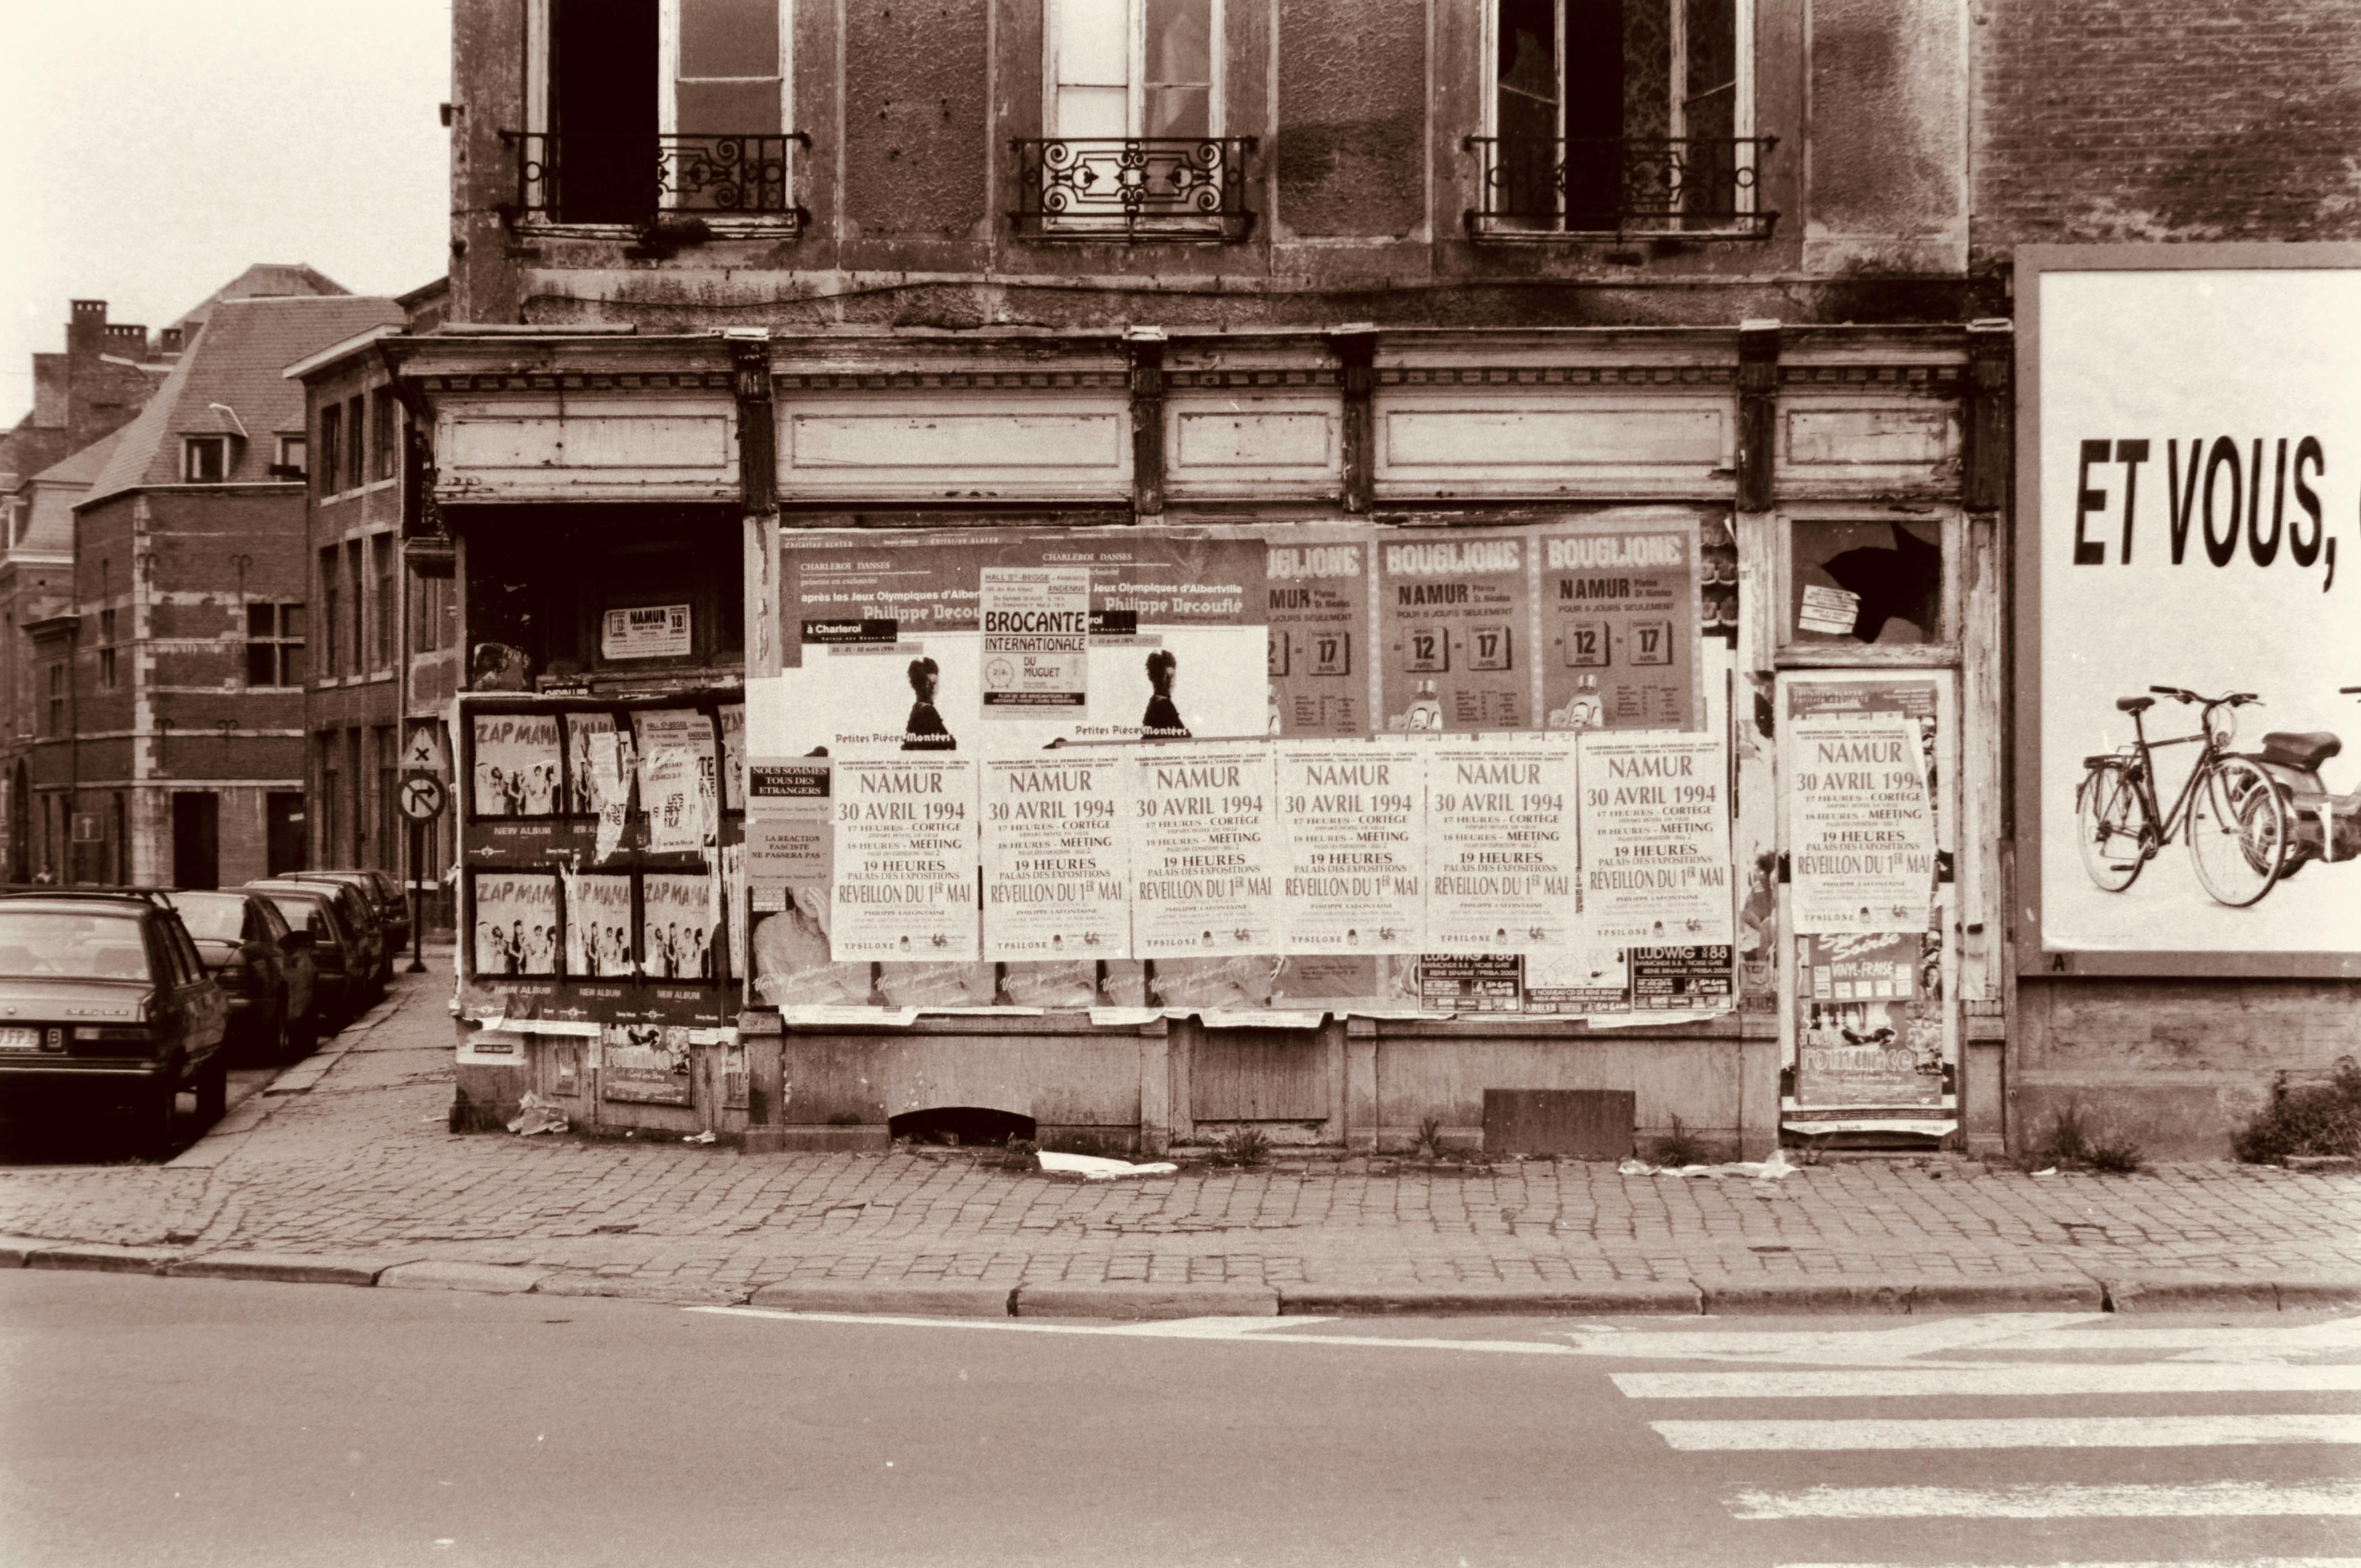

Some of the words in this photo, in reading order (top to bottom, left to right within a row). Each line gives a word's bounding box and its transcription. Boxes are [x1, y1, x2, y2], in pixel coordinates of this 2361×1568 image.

[2073, 439, 2150, 566] ET
[2167, 435, 2337, 593] VOUS,
[1100, 553, 1132, 561] DANSES
[1387, 540, 1520, 575] BOUGLIONE
[1548, 535, 1682, 569] BOUGLIONE
[801, 593, 830, 604] après
[834, 593, 848, 601] les
[851, 592, 874, 601] Jeux
[877, 590, 938, 601] Olympiques
[941, 590, 980, 599] d'Alber
[1094, 584, 1116, 593] Jeux
[1119, 583, 1177, 594] Olympiques
[1180, 583, 1243, 594] d'Albertville
[1398, 584, 1468, 605] NAMUR
[1560, 578, 1629, 599] NAMUR
[1105, 597, 1168, 615] Philippe
[1172, 597, 1243, 613] Decouflé
[1270, 589, 1310, 609] MUR
[630, 610, 665, 624] NAMUR
[671, 615, 682, 628] 18
[862, 605, 929, 623] Philippe
[932, 604, 980, 619] Decou
[986, 611, 1085, 632] BROCANTE
[1304, 614, 1352, 622] SEULEMENT
[1397, 610, 1420, 618] POUR
[1432, 609, 1459, 617] JOURS
[1464, 607, 1513, 616] SEULEMENT
[807, 625, 813, 633] à
[816, 624, 862, 633] Charleroi
[985, 638, 1085, 651] INTERNATIONALE
[1413, 636, 1435, 659] 12
[1477, 634, 1497, 658] 17
[1574, 631, 1596, 654] 12
[1639, 629, 1659, 652] 17
[1318, 639, 1337, 663] 17
[1024, 657, 1036, 666] DU
[1024, 668, 1060, 678] MUGUET
[476, 722, 513, 744] ZAP
[836, 734, 870, 743] Petites
[905, 733, 951, 742] Montées
[1076, 726, 1110, 735] Petites
[1143, 724, 1189, 735] Montées
[1819, 743, 1900, 764] NAMUR
[1307, 765, 1389, 786] NAMUR
[1457, 764, 1541, 785] NAMUR
[1609, 755, 1692, 778] NAMUR
[861, 773, 942, 793] NAMUR
[1010, 770, 1092, 793] NAMUR
[1157, 766, 1240, 789] NAMUR
[1797, 774, 1817, 791] 30
[1824, 773, 1874, 791] AVRIL
[1882, 772, 1923, 790] 1994
[1285, 796, 1305, 813] 30
[1312, 795, 1362, 812] AVRIL
[1371, 794, 1412, 812] 1994
[1435, 794, 1456, 812] 30
[1462, 794, 1513, 811] AVRIL
[1521, 794, 1563, 812] 1994
[1587, 788, 1608, 806] 30
[1615, 787, 1666, 805] AVRIL
[1674, 785, 1716, 803] 1994
[839, 803, 859, 820] 30
[866, 803, 915, 820] AVRIL
[924, 803, 965, 820] 1994
[989, 803, 1009, 820] 30
[1016, 801, 1065, 819] AVRIL
[1073, 800, 1115, 818] 1994
[1137, 799, 1157, 817] 30
[1163, 797, 1214, 815] AVRIL
[1222, 795, 1263, 814] 1994
[1868, 809, 1920, 819] MEETING
[1357, 831, 1409, 841] MEETING
[1507, 831, 1559, 841] MEETING
[1661, 822, 1713, 833] MEETING
[1822, 833, 1836, 842] 19
[1841, 831, 1904, 842] HEURES
[910, 839, 961, 849] MEETING
[1060, 836, 1112, 847] MEETING
[1209, 832, 1261, 844] MEETING
[1310, 855, 1324, 864] 19
[1330, 854, 1393, 864] HEURES
[1460, 853, 1474, 863] 19
[1479, 852, 1543, 863] HEURES
[1614, 847, 1628, 857] 19
[1634, 844, 1698, 856] HEURES
[864, 862, 877, 871] 19
[883, 861, 946, 871] HEURES
[1015, 861, 1028, 871] 19
[1034, 858, 1096, 870] HEURES
[1163, 857, 1177, 867] 19
[1182, 855, 1246, 867] HEURES
[1798, 852, 1860, 874] RÉVEILLON
[1905, 855, 1930, 873] MAI
[1286, 874, 1349, 897] RÉVEILLON
[1394, 878, 1418, 895] MAI
[1435, 873, 1498, 895] RÉVEILLON
[1544, 877, 1569, 895] MAI
[1590, 867, 1654, 890] RÉVEILLON
[1699, 868, 1724, 886] MAI
[477, 882, 514, 902] ZAP
[515, 884, 556, 905] MAM
[644, 882, 668, 901] ZAP
[839, 882, 902, 903] RÉVEILLON
[947, 885, 971, 902] MAI
[991, 881, 1053, 903] RÉVEILLON
[1098, 882, 1122, 900] MAI
[1139, 877, 1202, 900] RÉVEILLON
[1248, 878, 1272, 896] MAI
[1638, 946, 1696, 959] LUDWIG
[1710, 946, 1728, 959] 88
[1831, 961, 1894, 977] VINYL-FRAISE
[675, 991, 700, 1000] ALBUM
